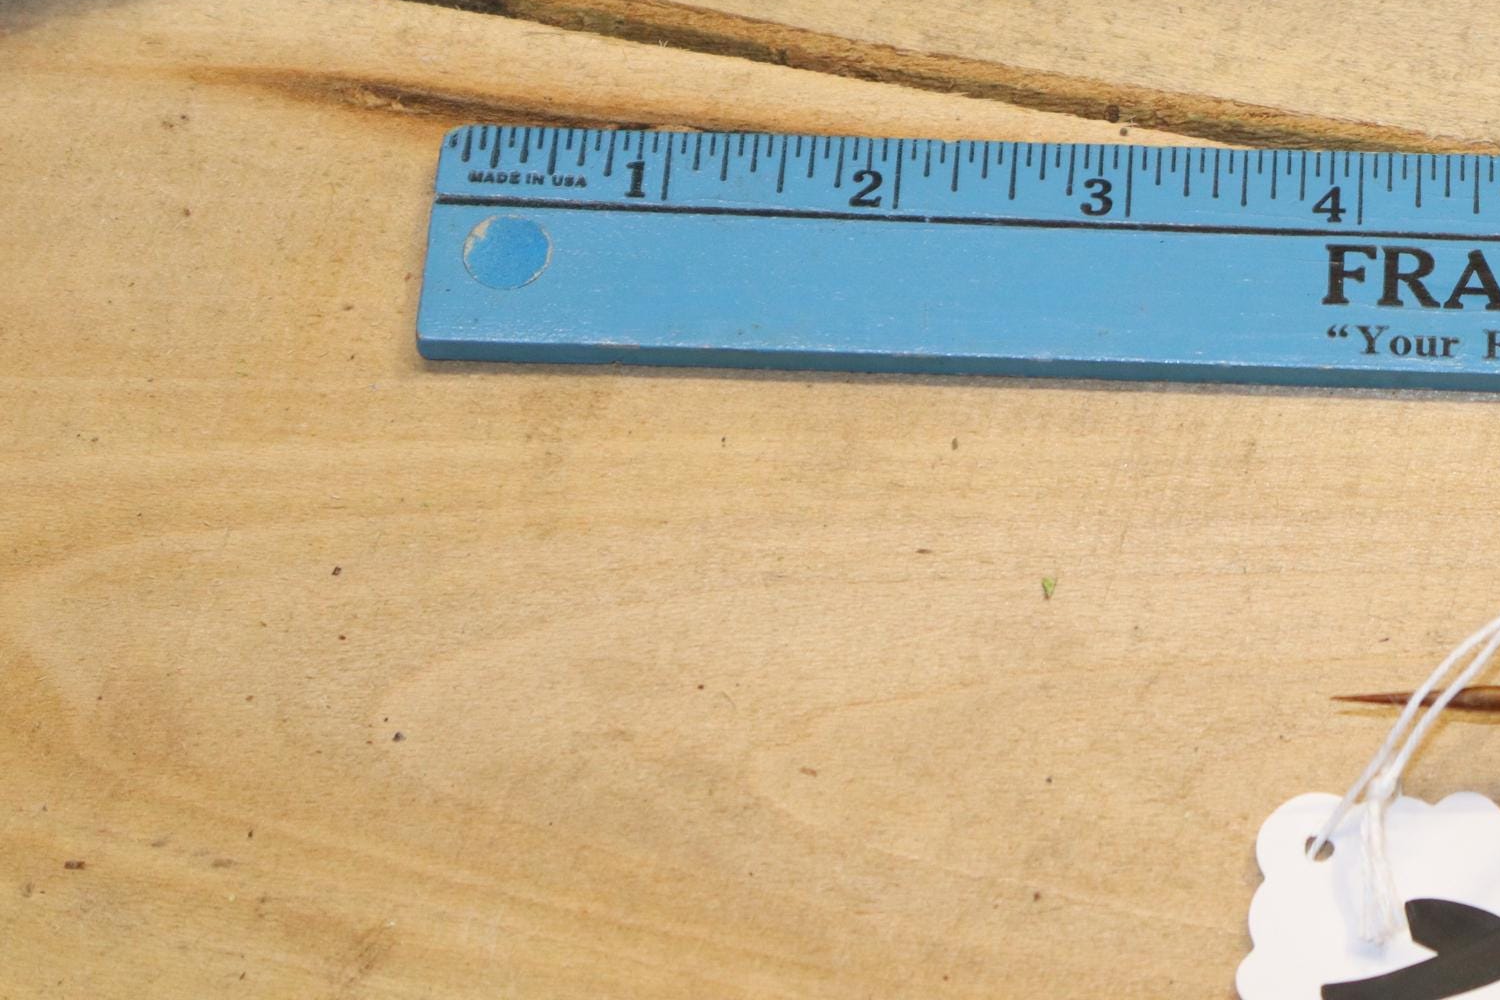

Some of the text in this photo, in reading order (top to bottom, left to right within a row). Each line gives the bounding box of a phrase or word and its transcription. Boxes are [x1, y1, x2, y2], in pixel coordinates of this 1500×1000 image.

[468, 170, 588, 188] MADE IN USA
[625, 160, 646, 198] 1
[848, 169, 884, 208] 2
[1080, 178, 1114, 216] 3
[1312, 186, 1347, 223] 4
[1326, 325, 1460, 360] “Your
